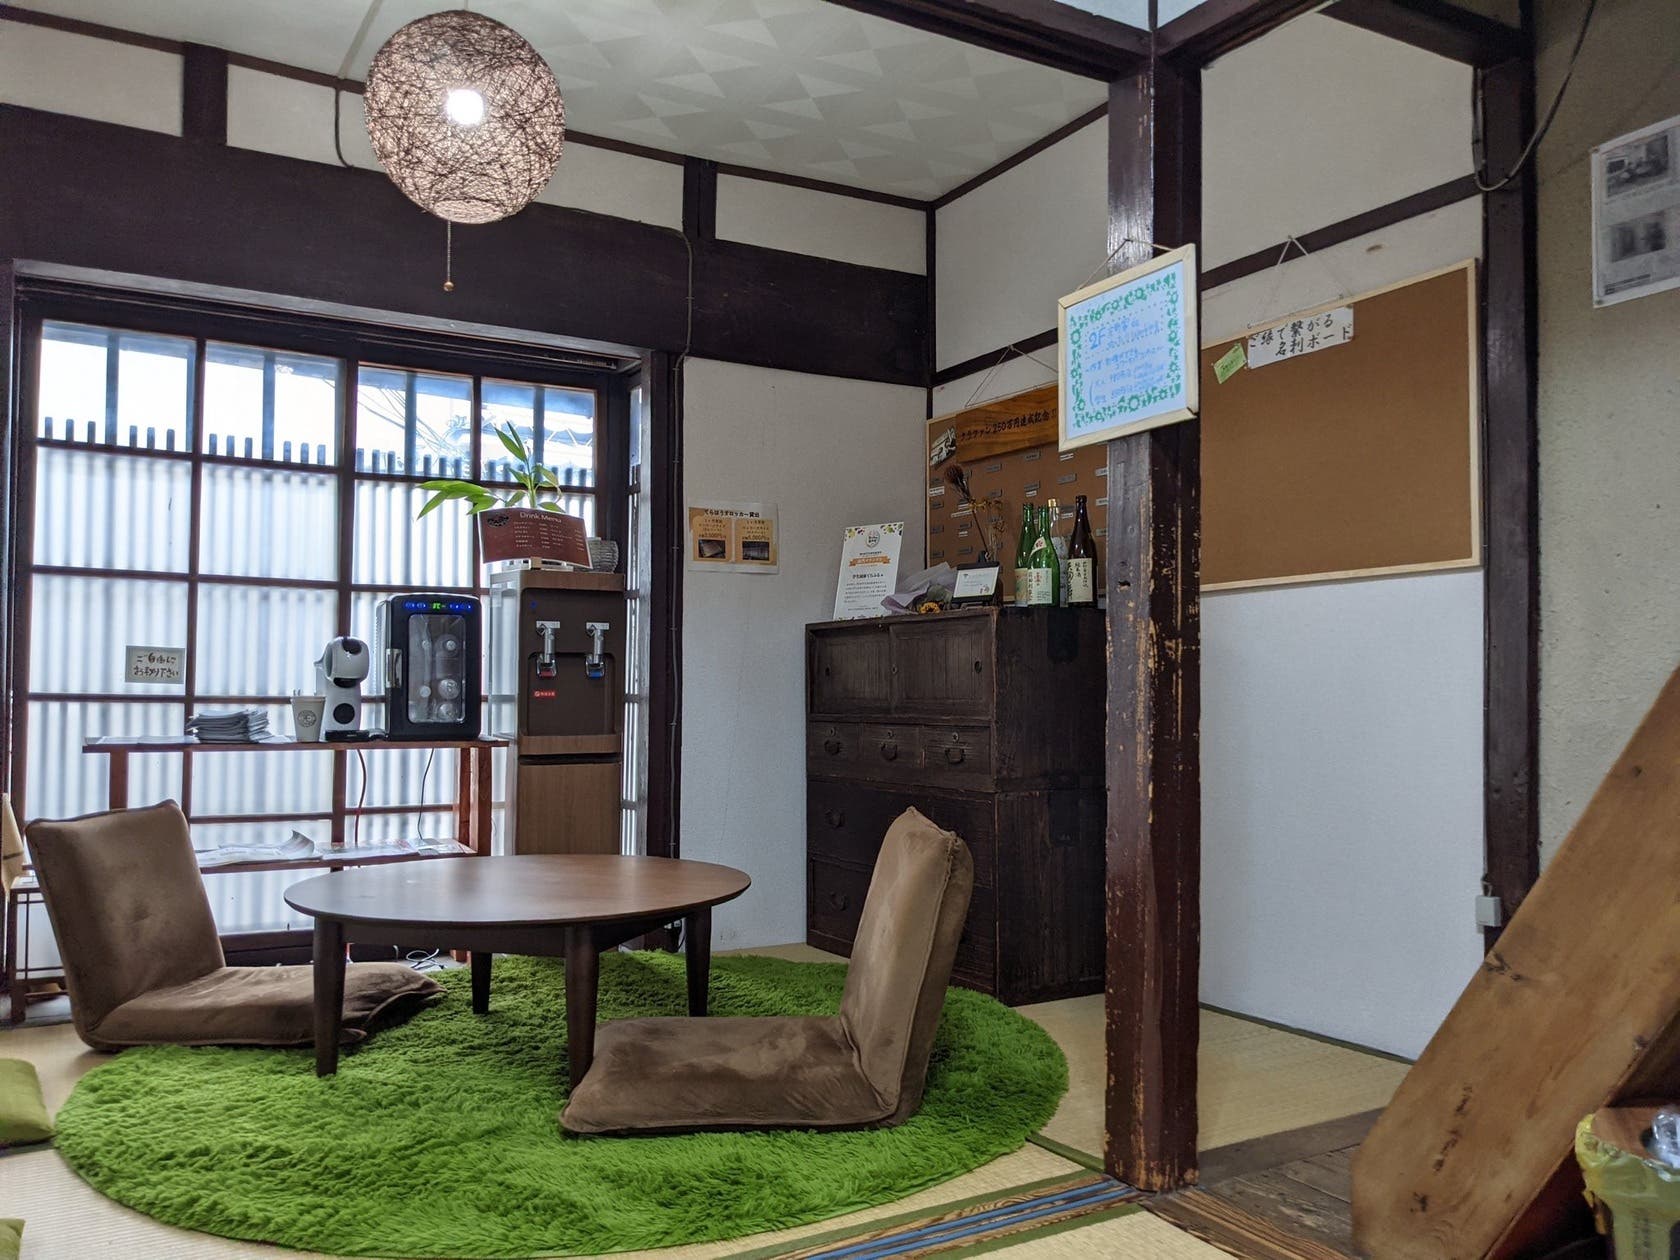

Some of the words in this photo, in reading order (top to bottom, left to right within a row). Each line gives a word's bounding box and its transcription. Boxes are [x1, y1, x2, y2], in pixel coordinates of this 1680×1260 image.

[1275, 323, 1352, 356] 名刺ボード
[520, 511, 540, 519] Drink
[541, 514, 562, 523] Menu
